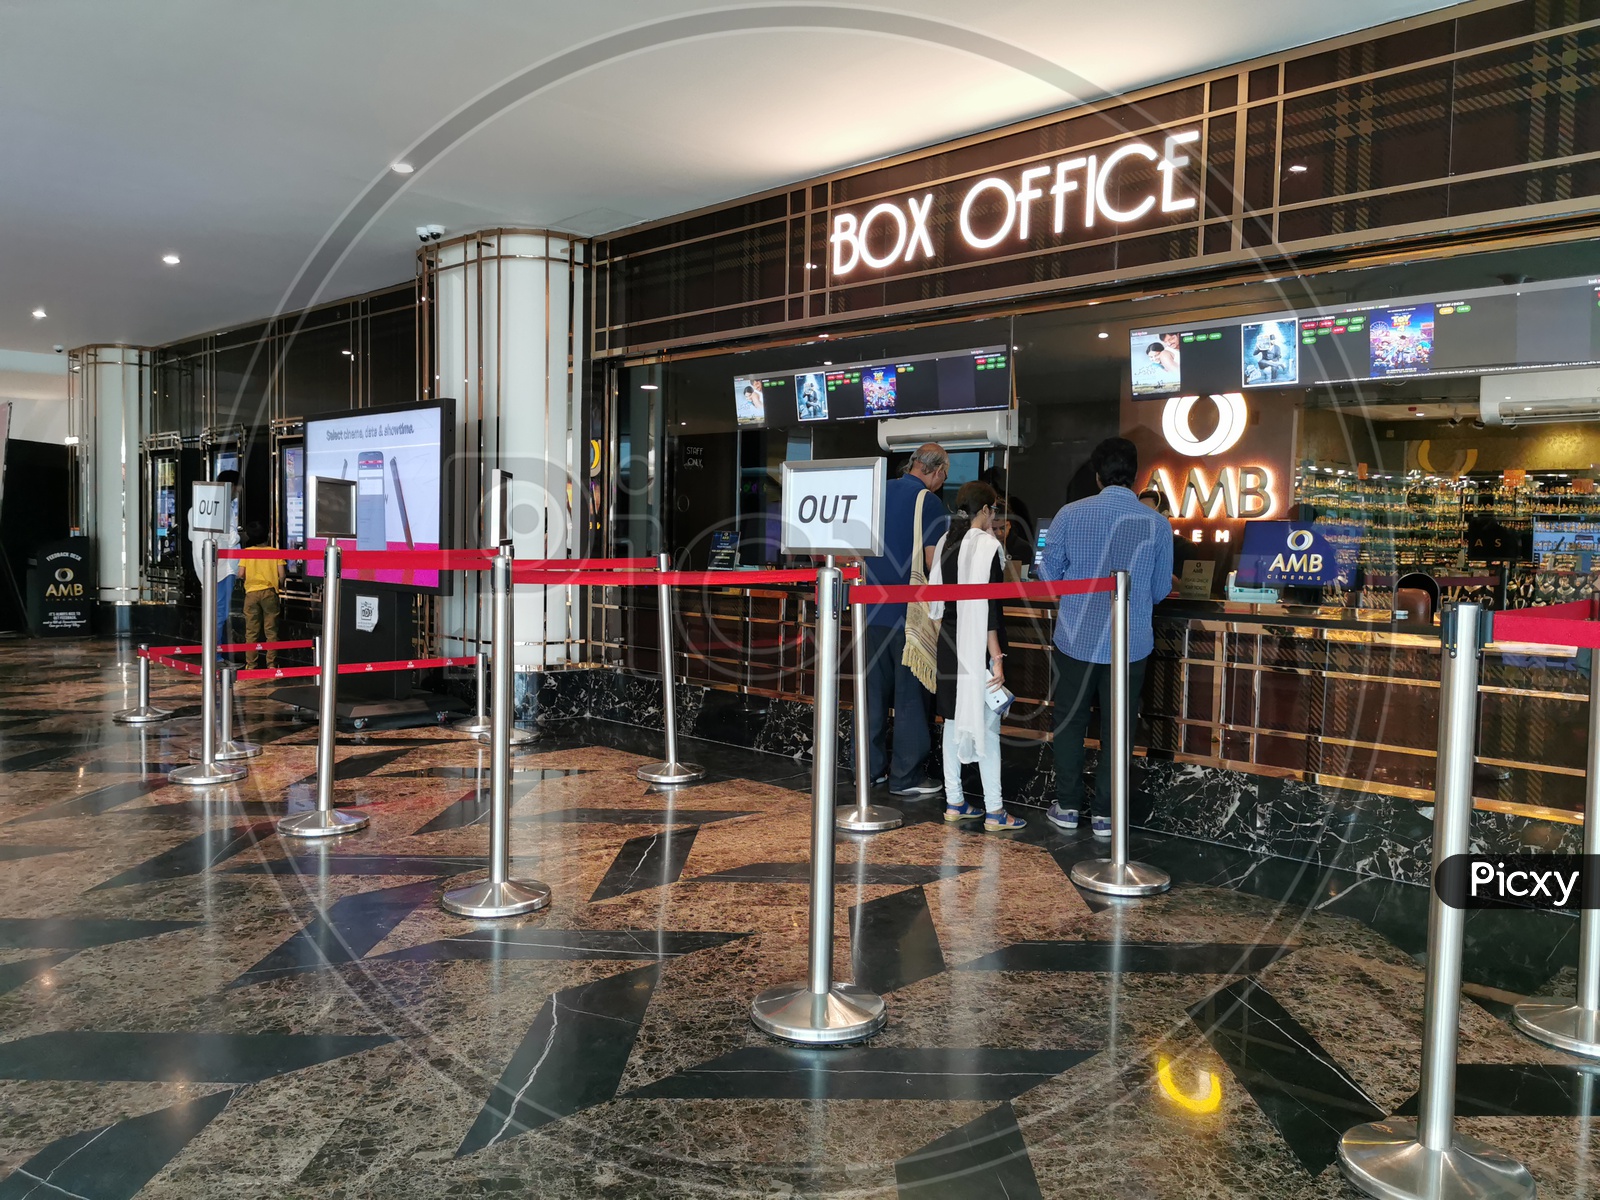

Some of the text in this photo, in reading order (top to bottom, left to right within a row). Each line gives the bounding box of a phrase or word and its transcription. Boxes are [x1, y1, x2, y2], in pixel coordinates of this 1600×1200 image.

[830, 130, 1199, 276] BOX OFFICE
[1391, 314, 1411, 323] TOY
[326, 428, 344, 441] Select
[343, 427, 364, 440] cinema,
[365, 425, 379, 438] date
[686, 446, 704, 456] STAFF
[686, 457, 704, 467] ONLY
[1146, 465, 1275, 519] AMB
[199, 499, 221, 517] OUT
[798, 494, 858, 524] OUT
[46, 552, 82, 561] FEEDBACK DESK
[1268, 552, 1324, 574] AMB
[45, 583, 84, 597] AMB
